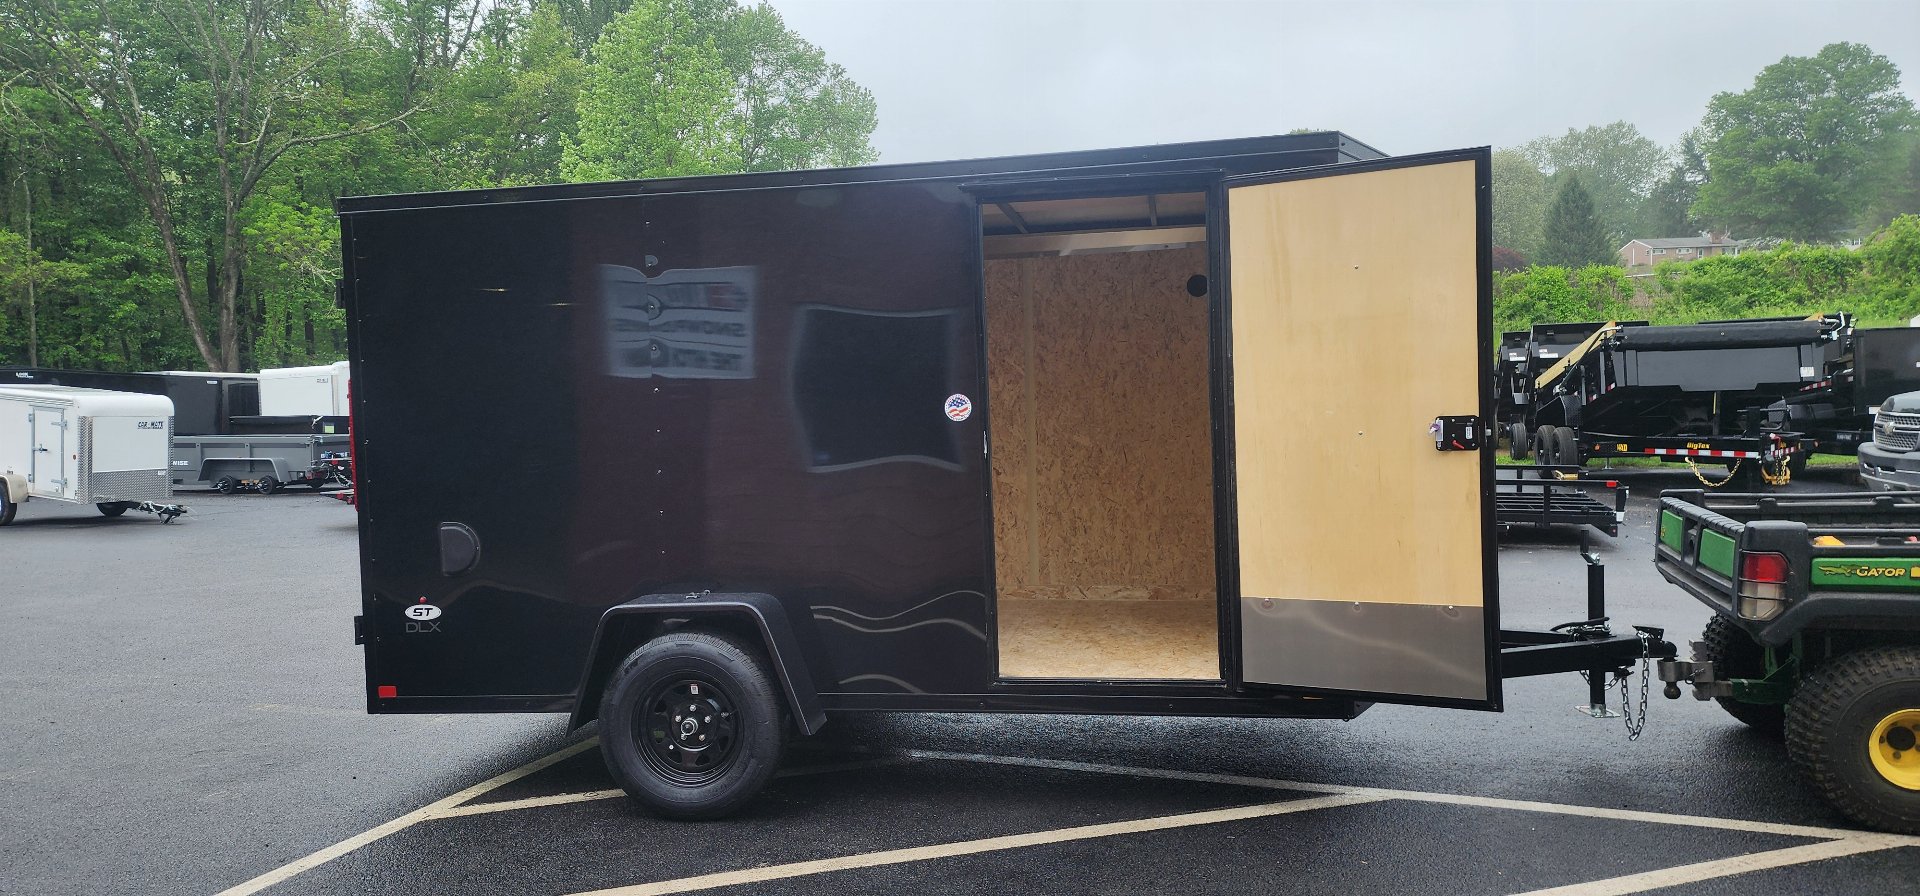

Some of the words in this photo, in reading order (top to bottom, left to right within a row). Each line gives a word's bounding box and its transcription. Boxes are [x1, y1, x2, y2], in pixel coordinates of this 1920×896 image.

[1856, 566, 1906, 577] GATOR
[413, 608, 433, 616] ST
[405, 621, 441, 633] DLX
